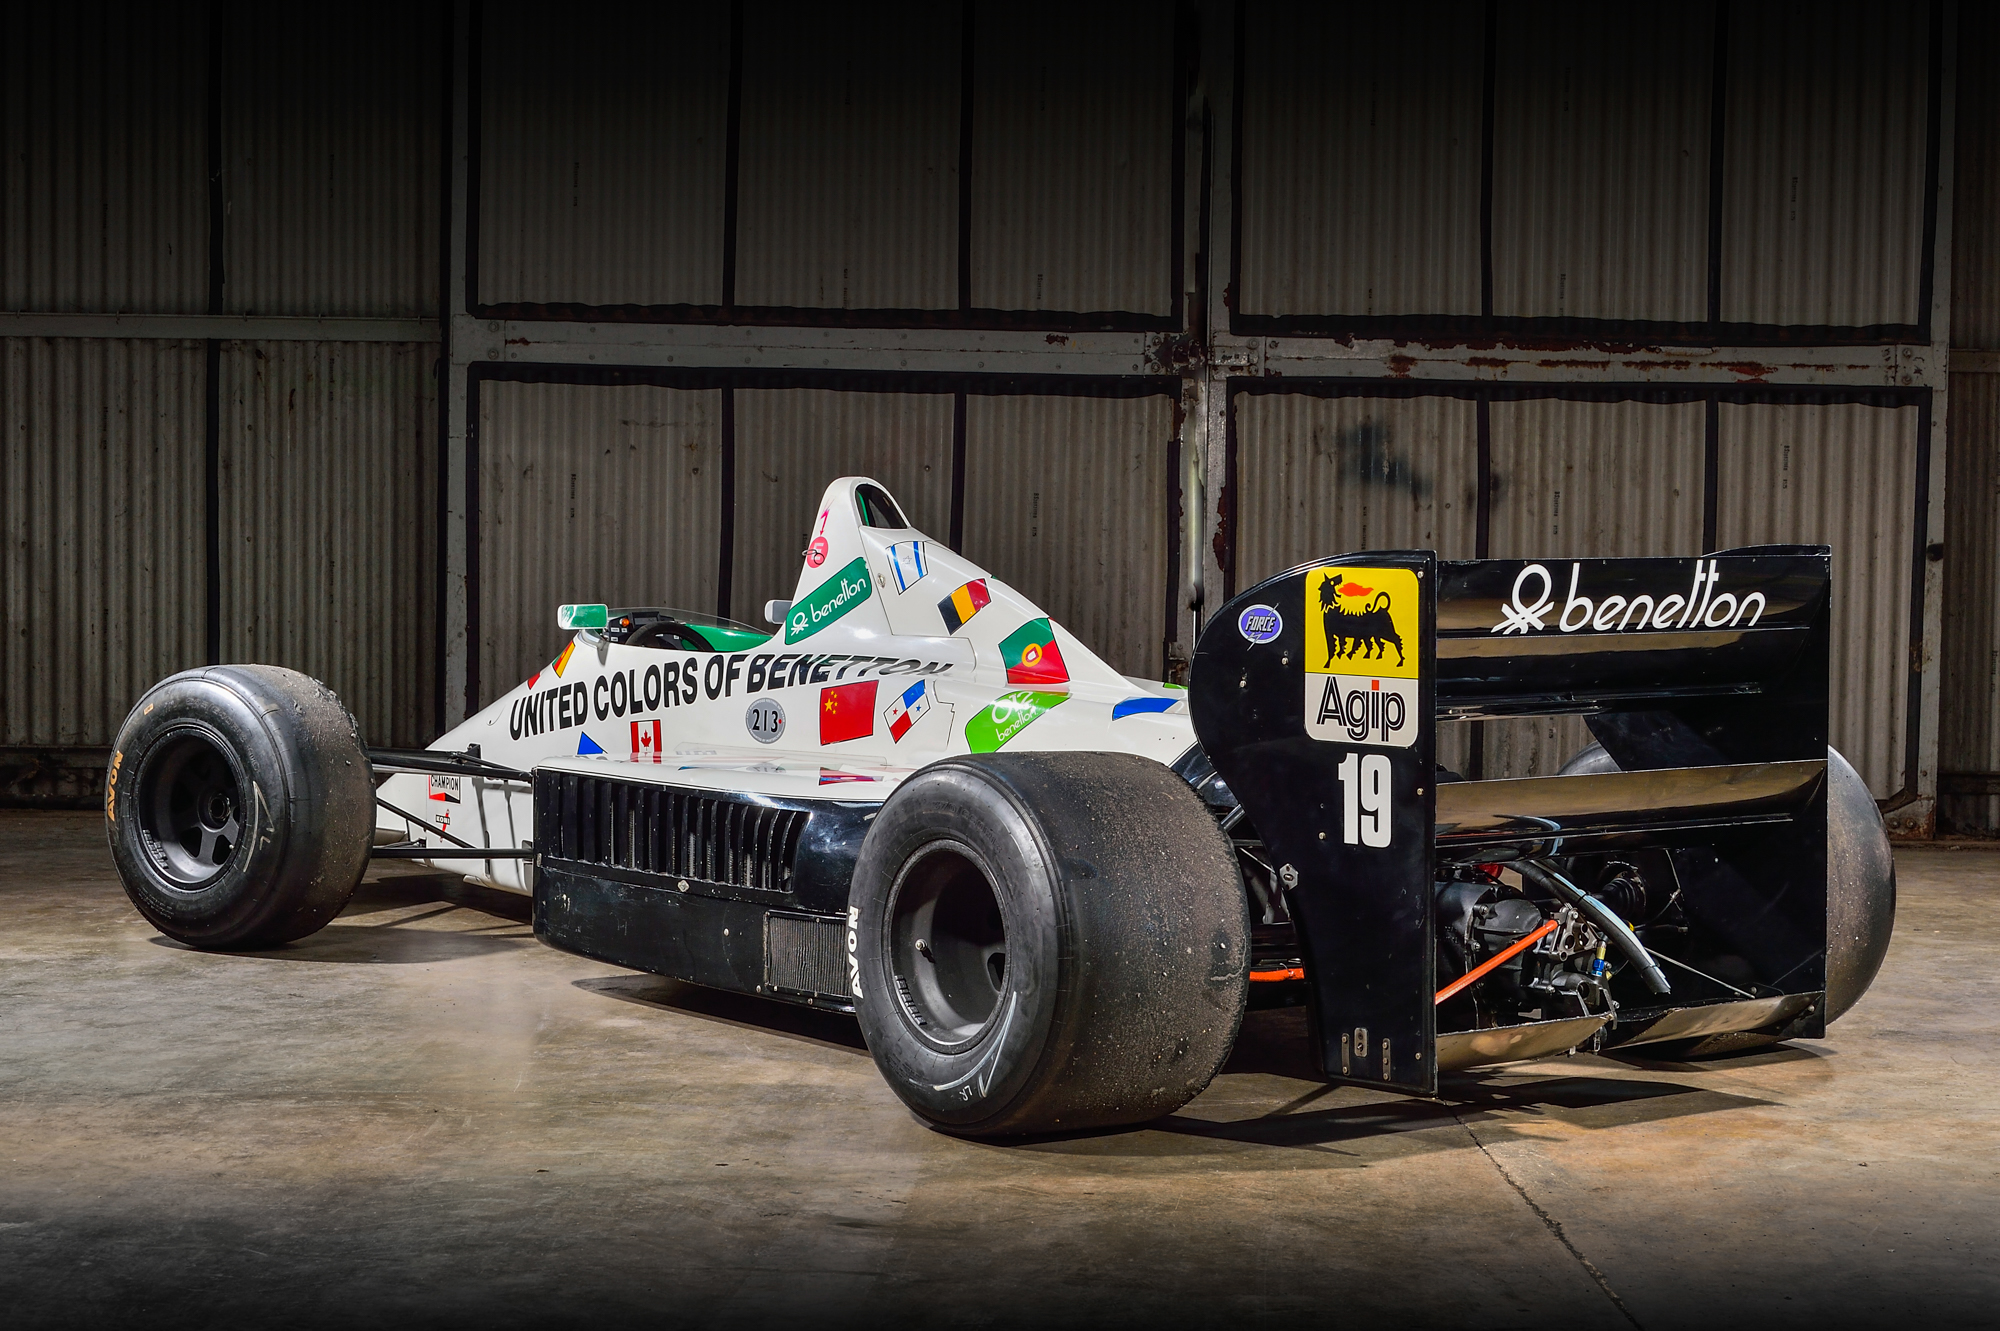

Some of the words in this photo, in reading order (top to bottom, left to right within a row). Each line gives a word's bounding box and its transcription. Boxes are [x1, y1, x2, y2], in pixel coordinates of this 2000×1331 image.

[810, 578, 867, 623] benetton
[1245, 615, 1276, 633] FORCE
[1559, 559, 1767, 633] benetton
[509, 681, 588, 741] UNITED
[592, 657, 698, 721] COLORS
[704, 653, 750, 700] OF
[747, 653, 954, 694] BENETTON
[752, 708, 779, 733] 213
[1316, 676, 1407, 742] Agip
[107, 750, 124, 821] AVON
[430, 775, 459, 791] CHAMPION
[1338, 752, 1392, 848] 19
[847, 906, 864, 999] AVON
